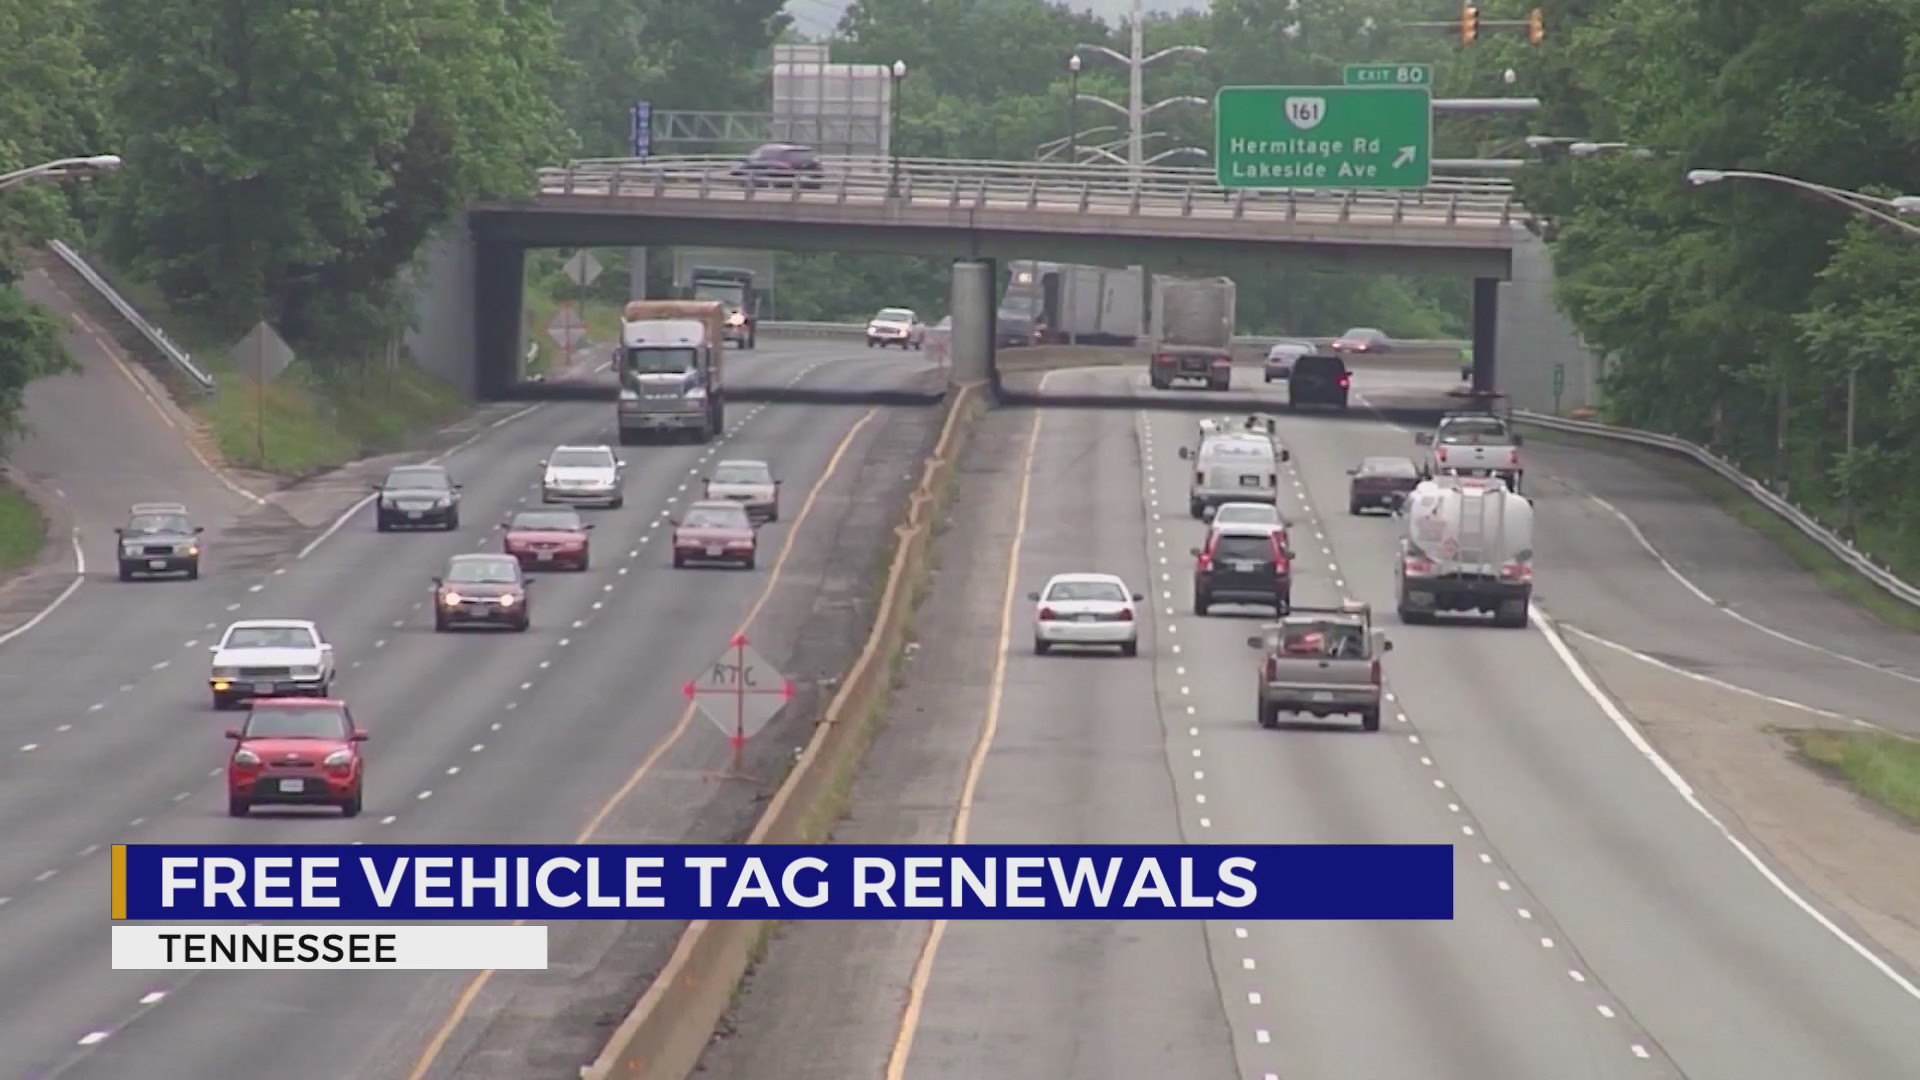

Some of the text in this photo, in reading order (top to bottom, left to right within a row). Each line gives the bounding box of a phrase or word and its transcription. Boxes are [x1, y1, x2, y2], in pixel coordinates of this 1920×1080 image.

[1358, 68, 1423, 82] EXIT 80
[1292, 104, 1319, 120] 161
[1231, 138, 1380, 157] Hermitage Rd
[1232, 162, 1377, 177] Lakeside Ave
